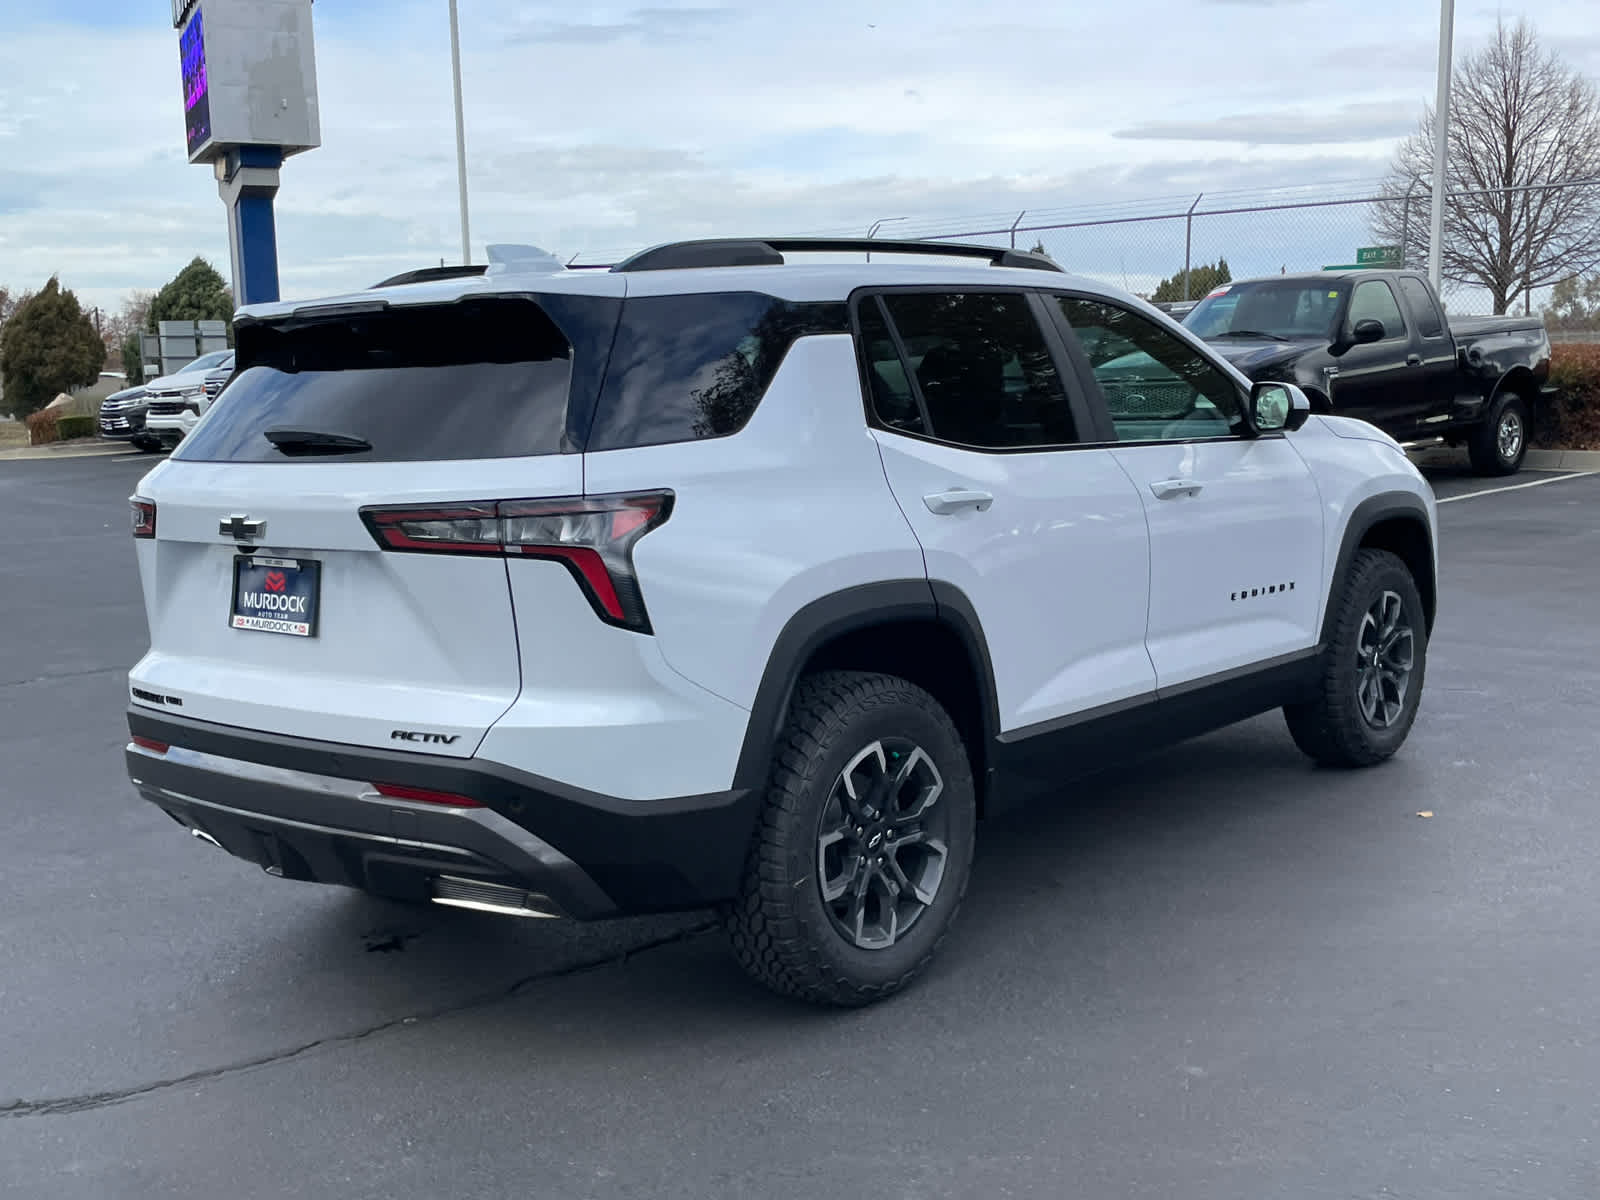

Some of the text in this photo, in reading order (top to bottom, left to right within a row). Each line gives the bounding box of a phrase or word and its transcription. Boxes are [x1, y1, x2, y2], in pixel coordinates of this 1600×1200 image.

[1230, 582, 1295, 601] EQUINOX
[243, 591, 305, 613] MURDOCK
[257, 611, 289, 620] AUTO TEAM
[251, 617, 292, 632] MURDOCK
[390, 730, 461, 744] ACTIV
